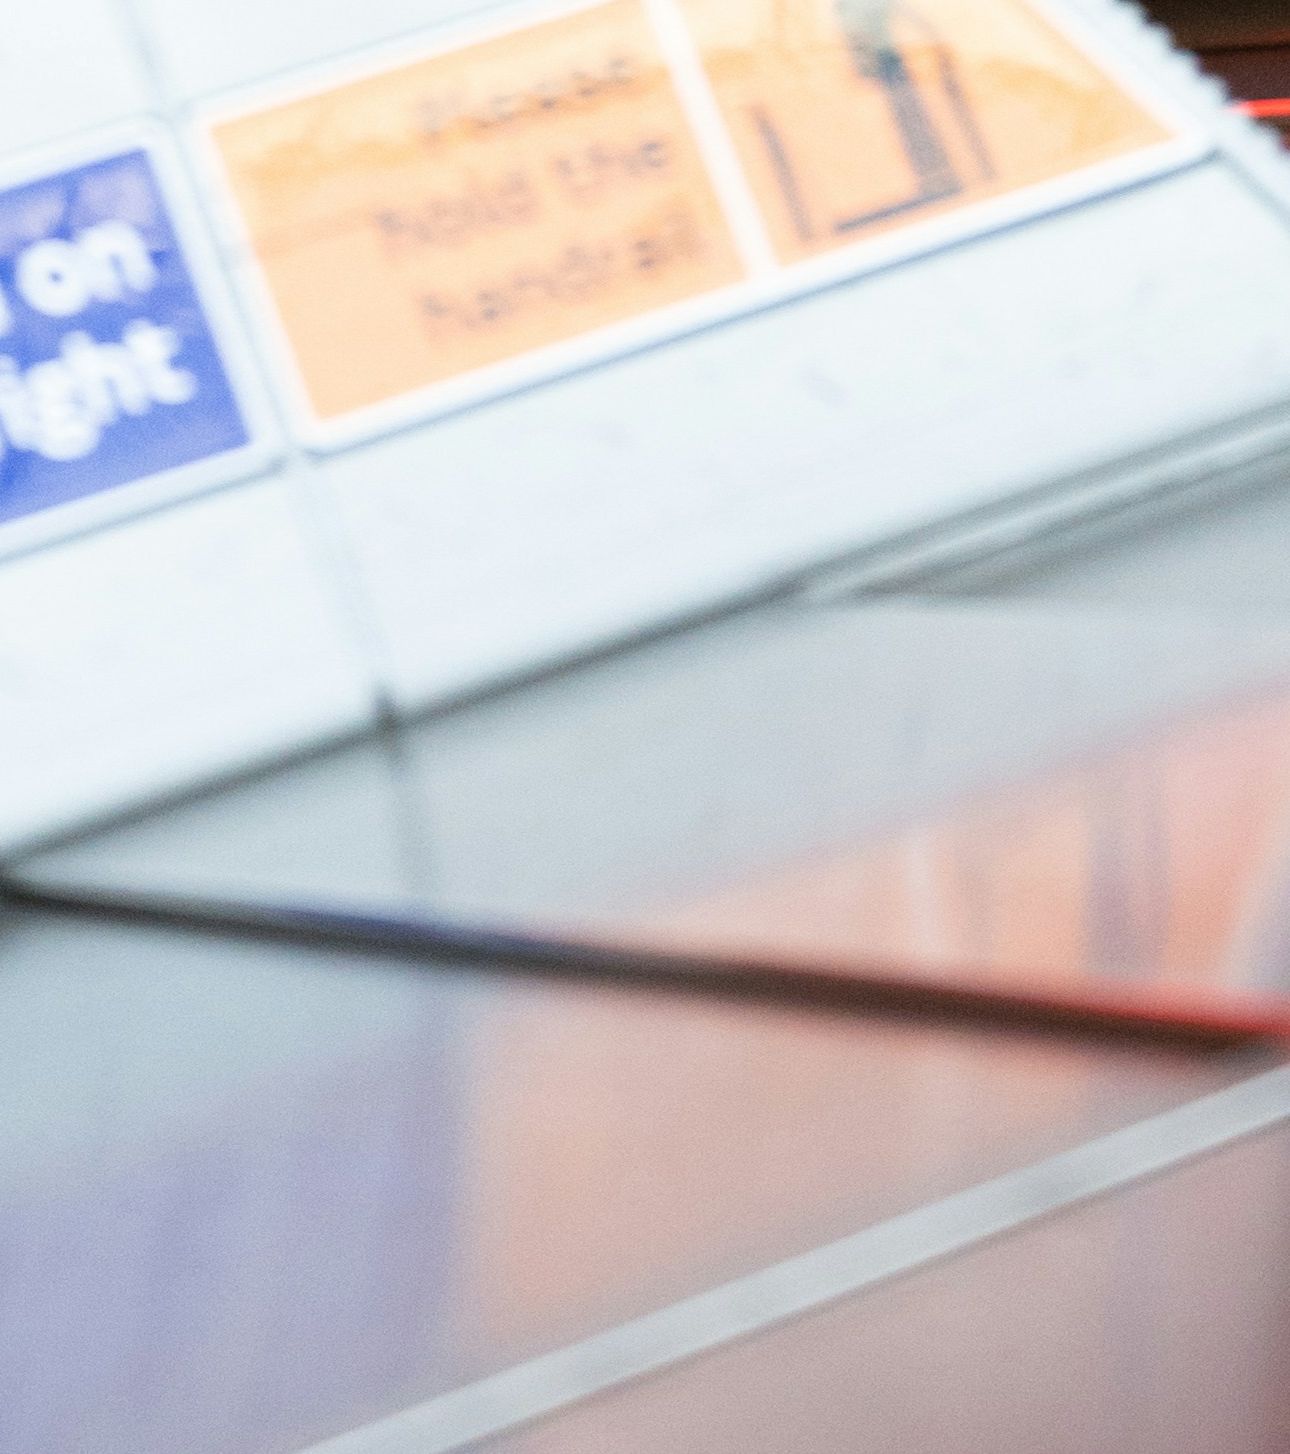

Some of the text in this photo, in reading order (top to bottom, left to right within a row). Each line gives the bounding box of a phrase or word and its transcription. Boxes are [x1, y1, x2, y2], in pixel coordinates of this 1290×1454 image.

[411, 52, 639, 142] Please
[375, 140, 675, 246] hold the
[15, 220, 157, 318] on
[411, 208, 701, 332] handrail
